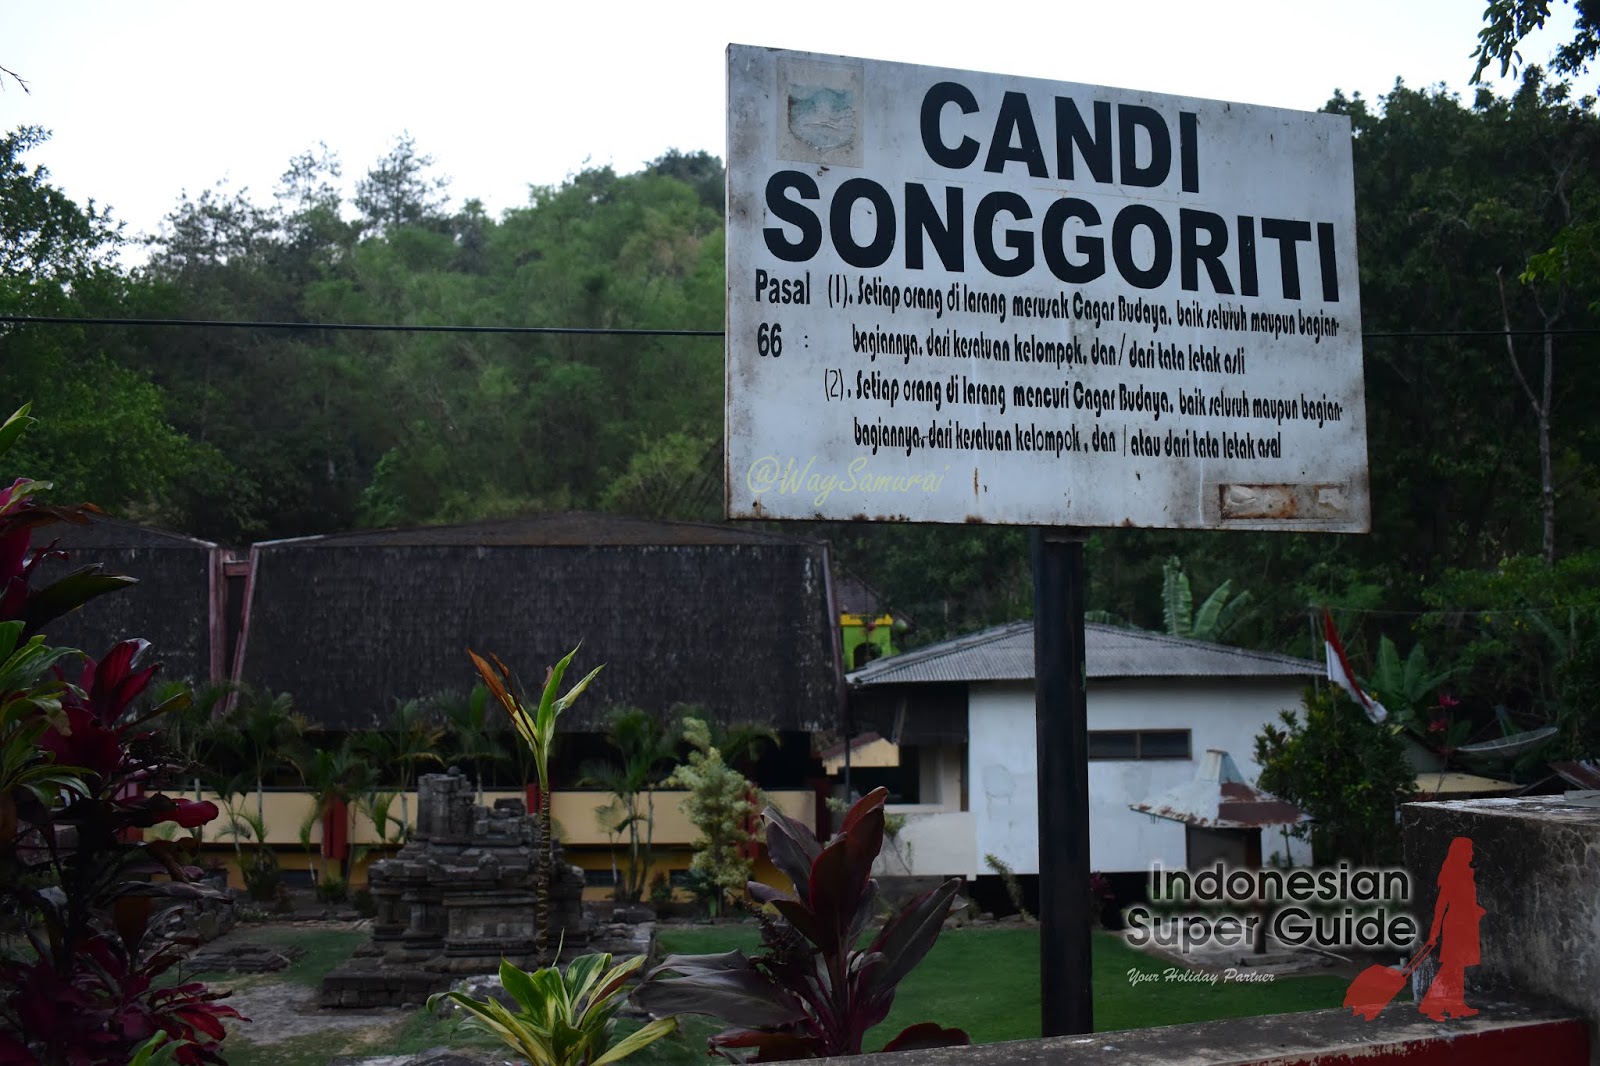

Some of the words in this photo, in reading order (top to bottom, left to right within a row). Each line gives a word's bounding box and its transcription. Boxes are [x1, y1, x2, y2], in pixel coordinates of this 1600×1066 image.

[919, 81, 1200, 194] CANDI
[762, 170, 1340, 303] SONGGORITI
[756, 269, 810, 305] Pasal
[857, 276, 901, 313] Setiap
[903, 287, 943, 319] orang
[947, 282, 960, 312] di
[963, 284, 1007, 323] larang
[1012, 291, 1069, 319] merusak
[1073, 291, 1115, 330] Cagar
[1177, 300, 1204, 328] baik
[1206, 303, 1248, 332] seluruh
[1250, 311, 1296, 340] maupun
[756, 323, 783, 358] 66
[926, 328, 951, 358] dari
[953, 330, 1010, 362] kesatuan
[1091, 337, 1117, 366] dan
[1128, 341, 1155, 371] dari
[1158, 342, 1185, 373] tata
[1188, 344, 1222, 374] letak
[1224, 346, 1245, 375] asli
[856, 370, 900, 408] Setiap
[903, 379, 942, 412] orang
[945, 374, 959, 404] di
[962, 375, 1006, 415] larang
[1012, 381, 1070, 409] mencuri
[1073, 381, 1116, 418] Cagar
[1178, 387, 1207, 416] baik
[1208, 390, 1250, 419] seluruh
[1252, 397, 1299, 425] maupun
[928, 420, 952, 451] dari
[955, 421, 1012, 451] kesatuan
[1091, 424, 1117, 453] dan
[1130, 429, 1161, 458] atau
[1164, 429, 1190, 458] dari
[1193, 431, 1220, 459] tata
[1222, 432, 1256, 460] letak
[1257, 432, 1282, 459] asal
